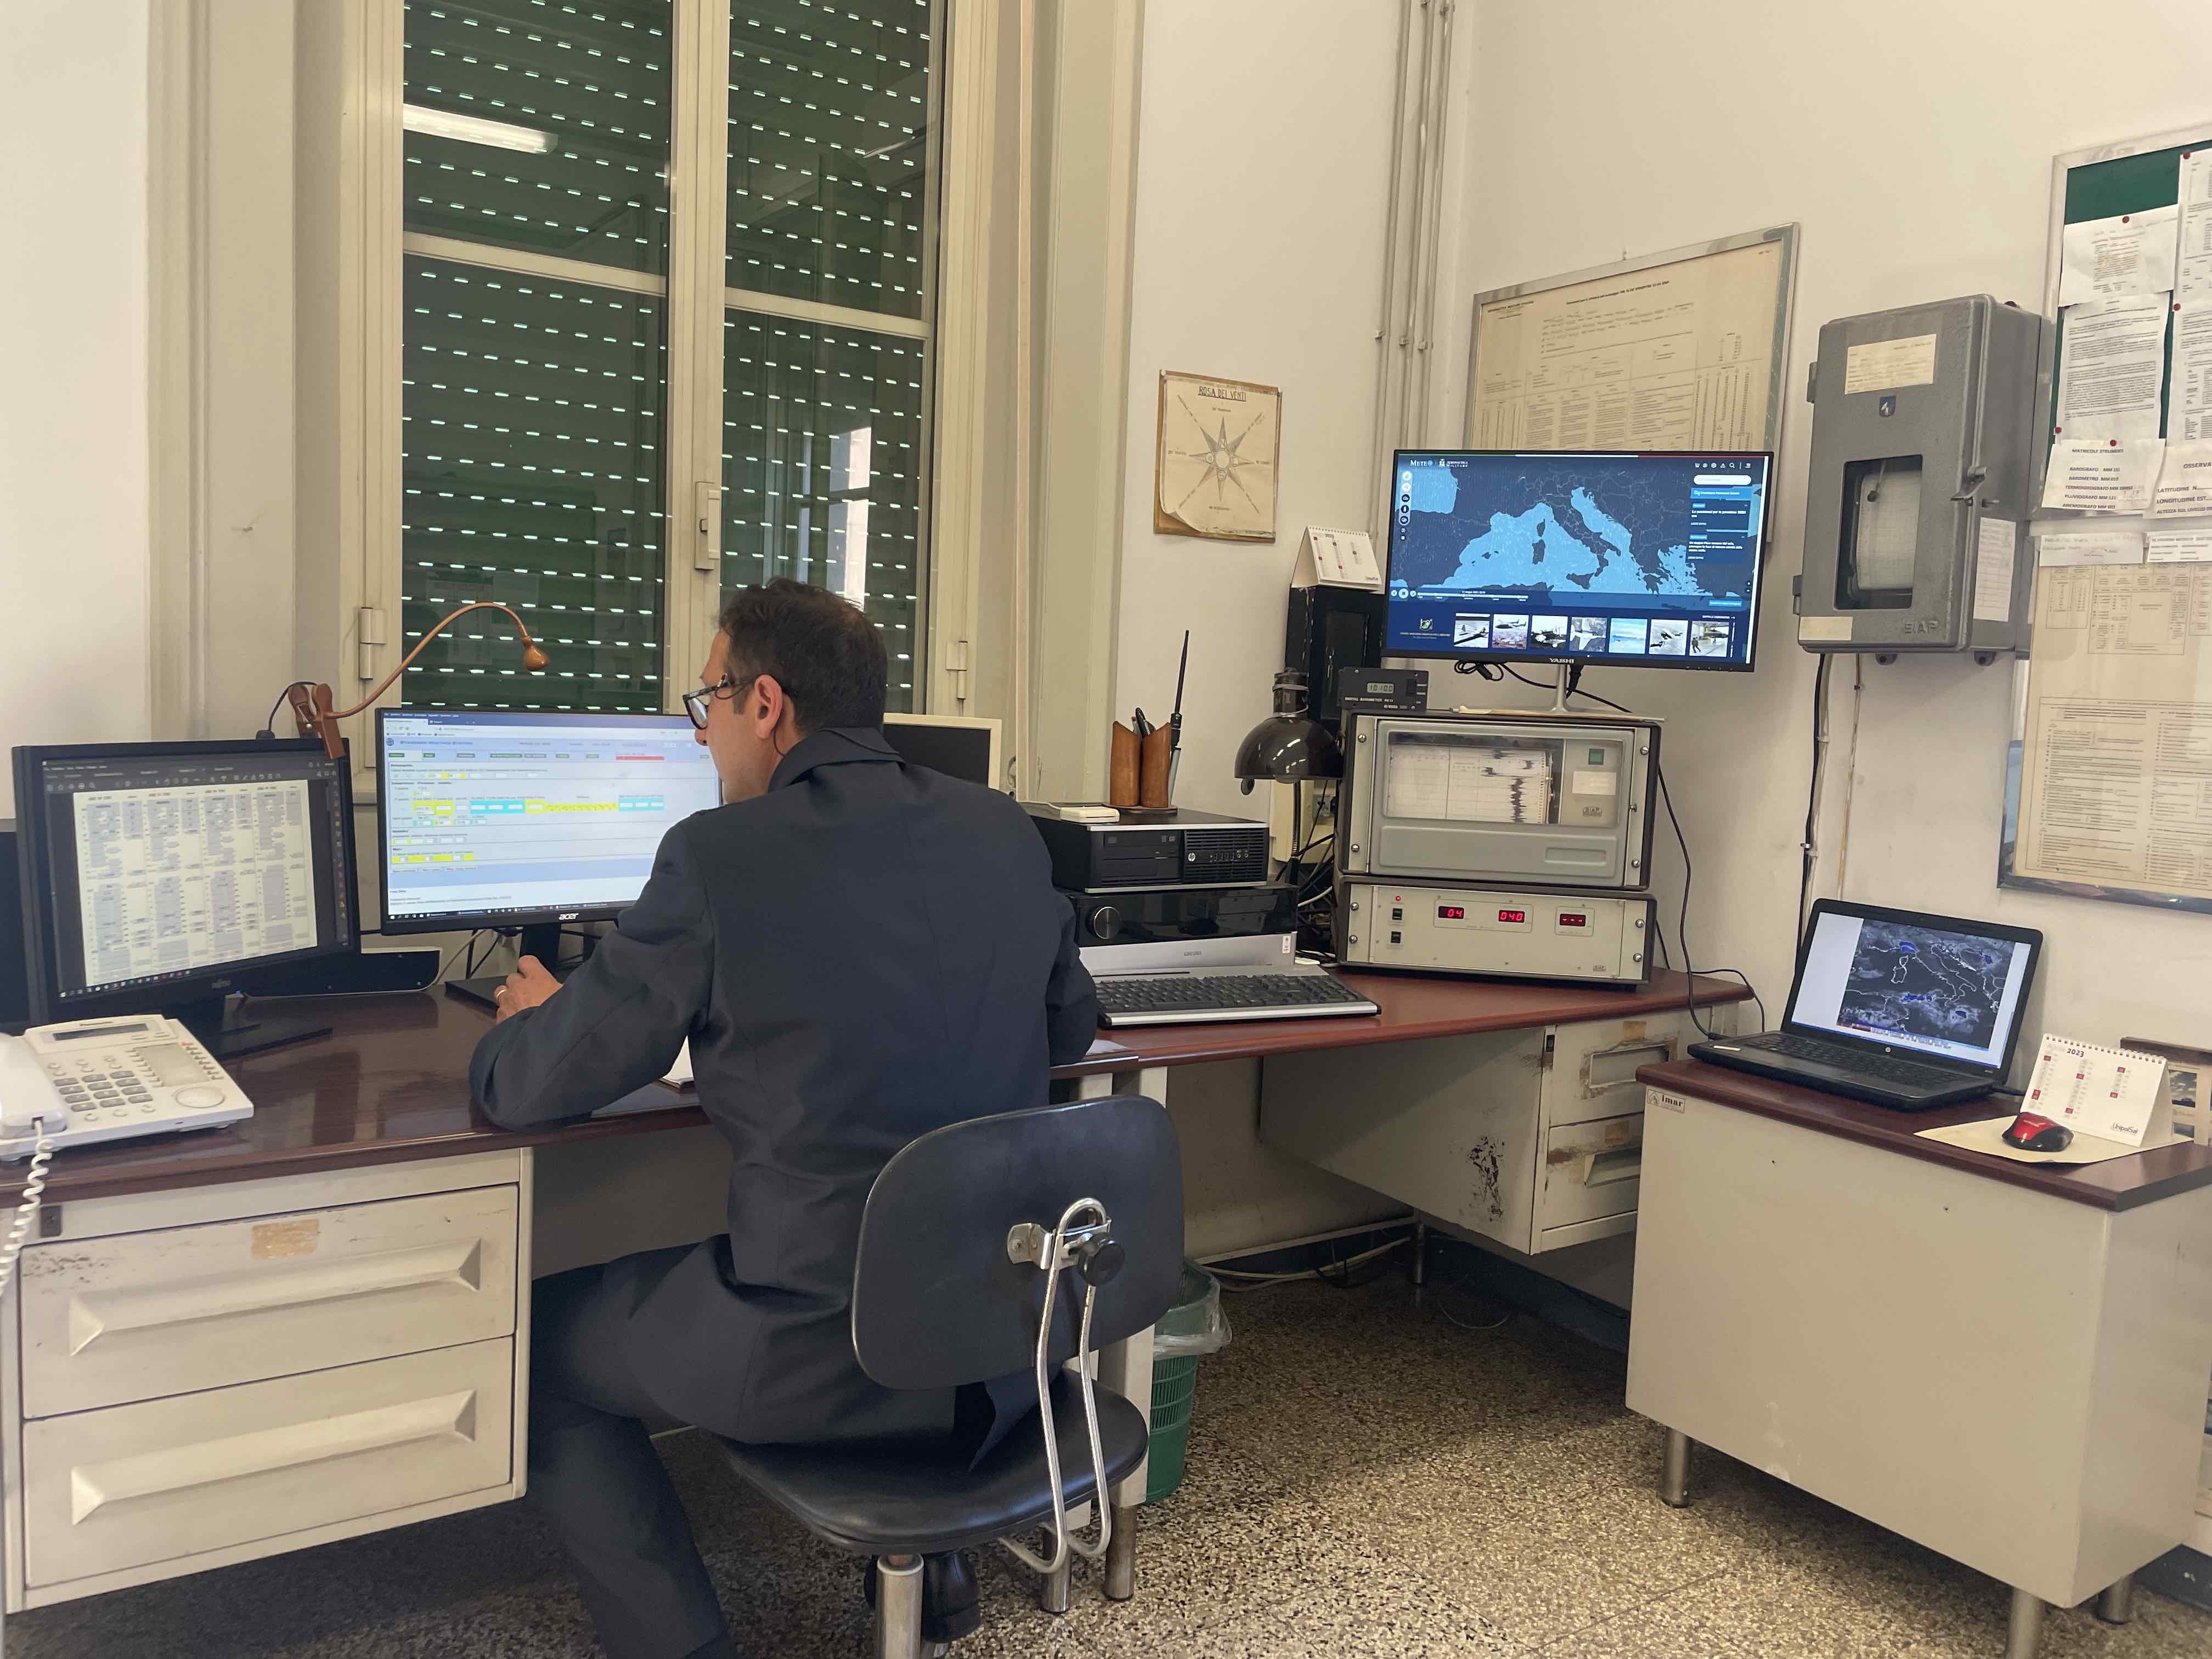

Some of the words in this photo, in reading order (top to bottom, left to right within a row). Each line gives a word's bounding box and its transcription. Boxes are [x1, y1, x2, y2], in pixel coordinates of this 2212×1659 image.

[1199, 386, 1216, 397] ROSA
[1230, 391, 1246, 401] VENTI
[1448, 909, 1463, 918] 04
[1499, 911, 1524, 921] 040
[2067, 1048, 2084, 1057] 2023
